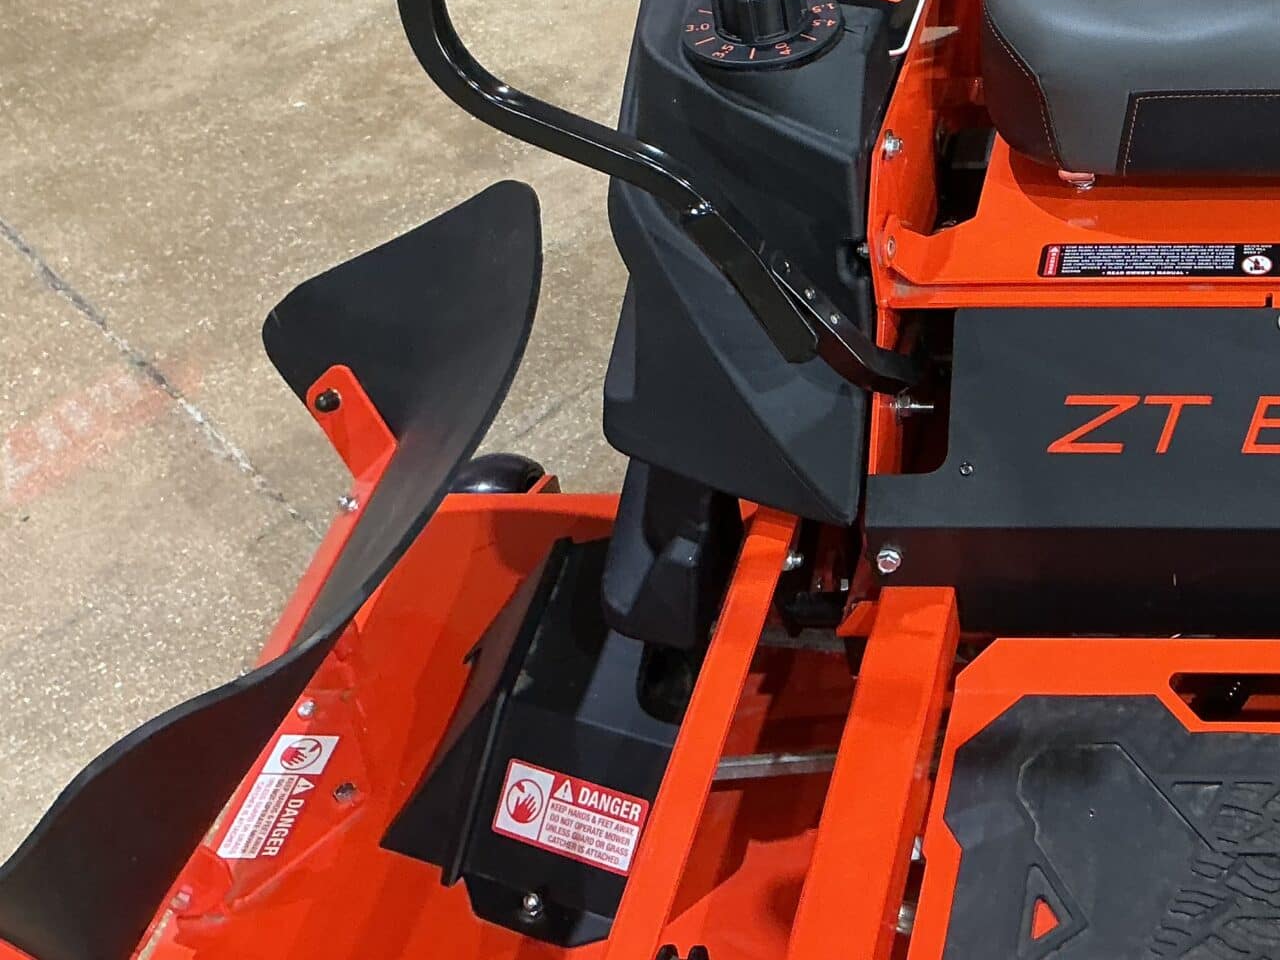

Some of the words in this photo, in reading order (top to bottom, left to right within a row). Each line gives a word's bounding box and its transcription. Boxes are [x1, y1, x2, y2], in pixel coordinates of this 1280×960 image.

[712, 44, 734, 59] 3.5
[1046, 395, 1213, 455] ZT
[550, 802, 567, 814] KEEP
[568, 808, 590, 822] HANDS
[591, 814, 597, 824] &
[598, 816, 614, 829] FEET
[578, 788, 642, 822] DANGER
[262, 800, 304, 856] DANGER
[546, 823, 570, 838] UNLESS
[571, 830, 594, 846] GUARD
[594, 838, 605, 848] OR
[606, 841, 630, 857] GRASS
[548, 835, 578, 852] CATCHER
[578, 843, 586, 854] IS
[550, 813, 560, 823] DO
[560, 816, 573, 828] NOT
[574, 820, 606, 838] OPERATE
[605, 831, 631, 846] MOWER
